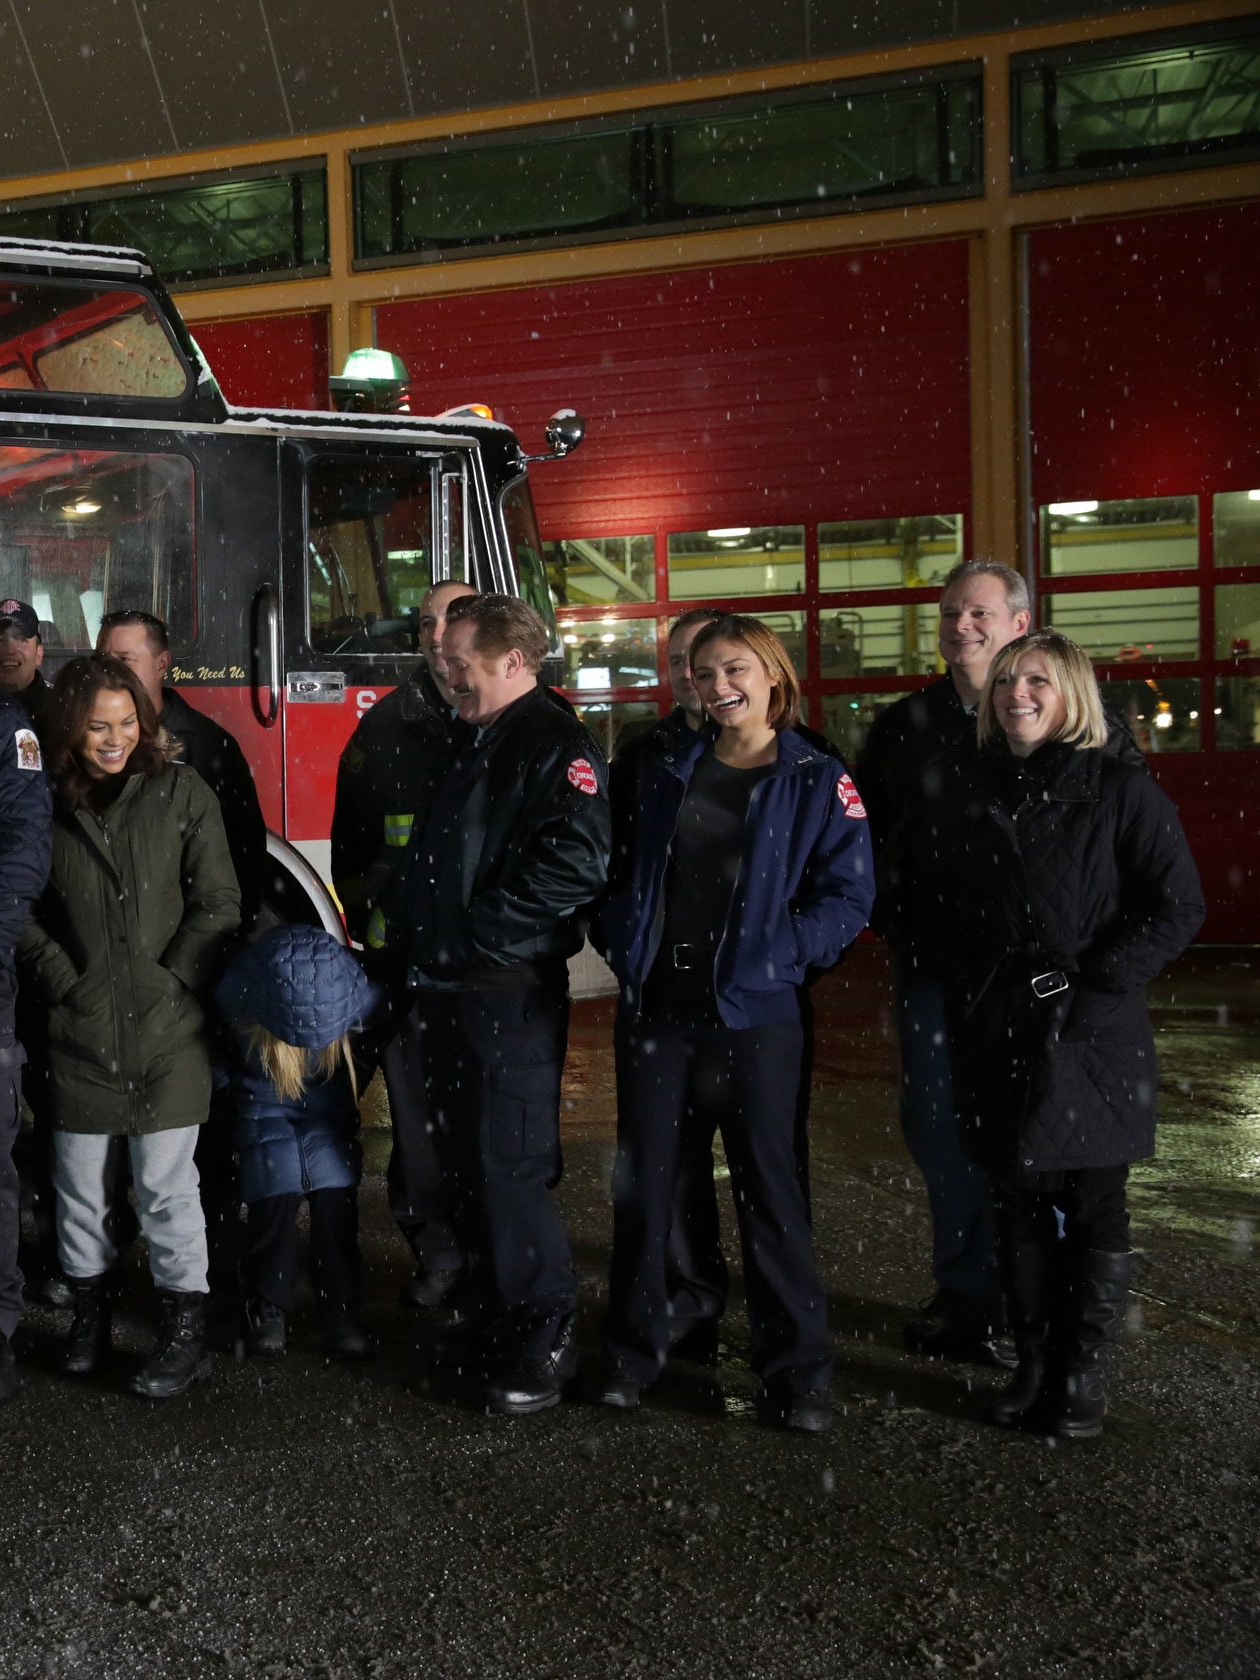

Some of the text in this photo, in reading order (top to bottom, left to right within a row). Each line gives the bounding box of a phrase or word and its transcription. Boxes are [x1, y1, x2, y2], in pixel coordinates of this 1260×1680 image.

[171, 666, 194, 682] You
[197, 665, 226, 680] Need
[228, 665, 246, 679] Us
[27, 751, 34, 765] 3
